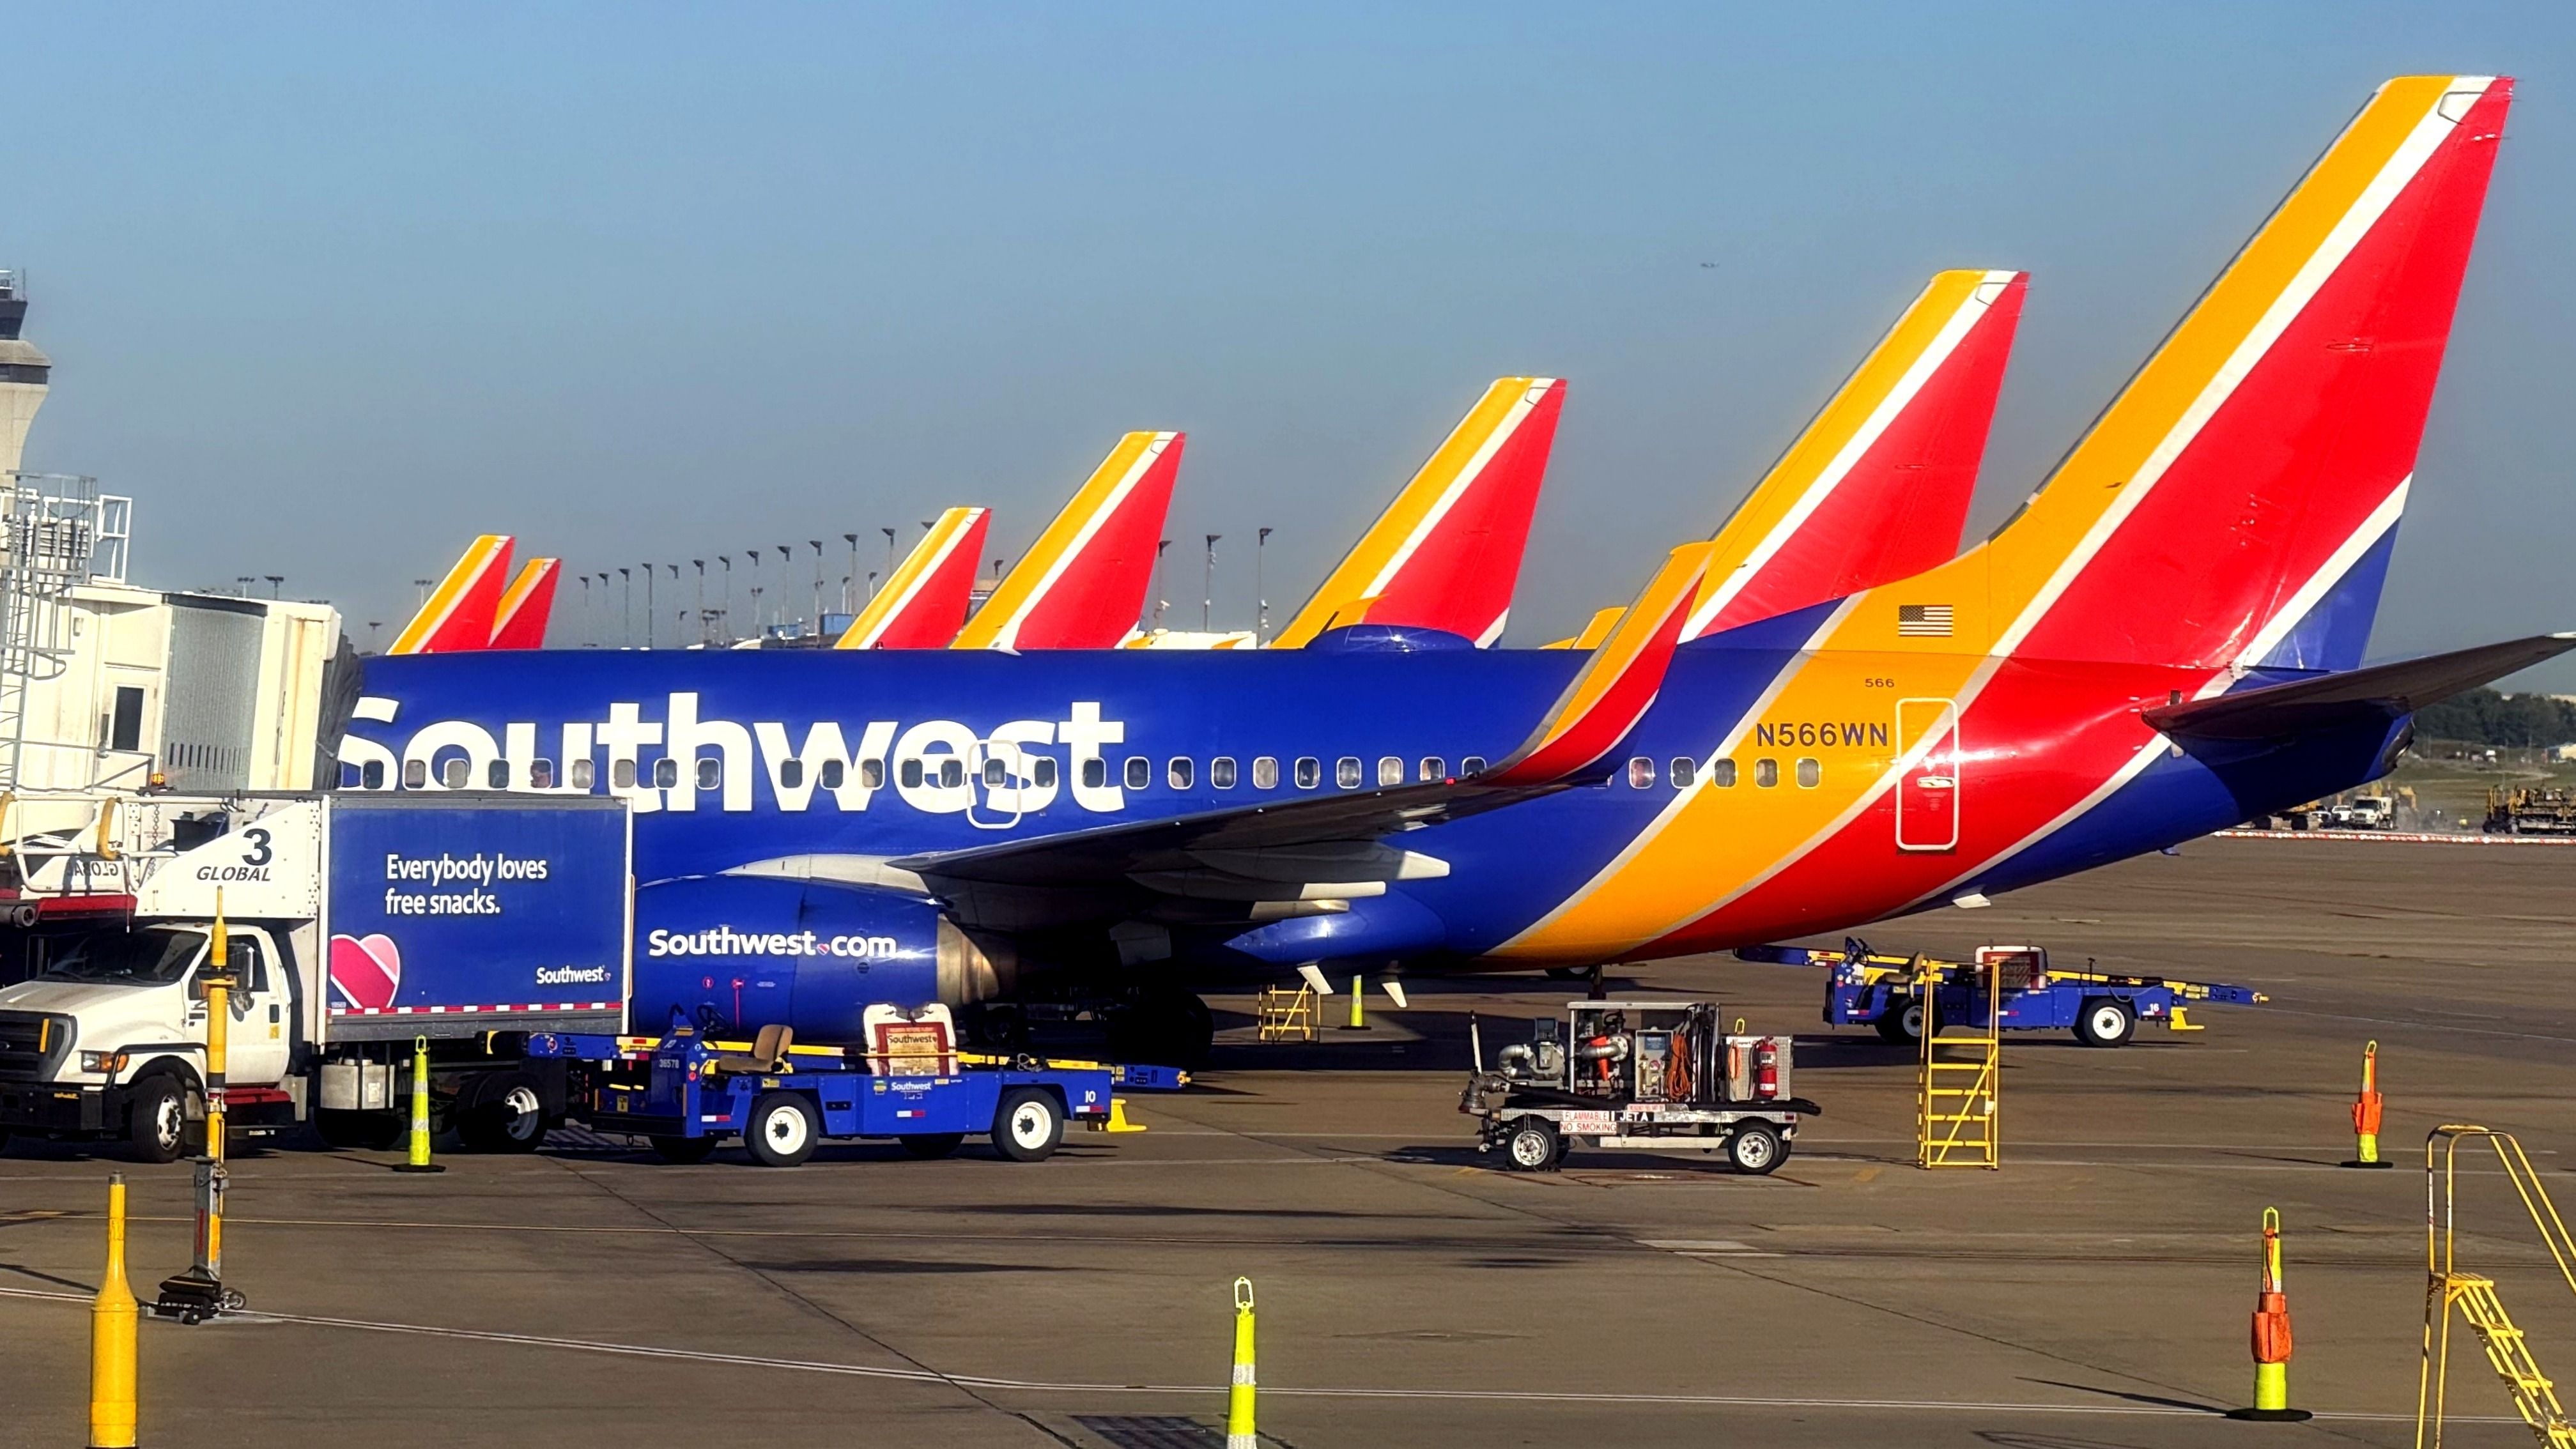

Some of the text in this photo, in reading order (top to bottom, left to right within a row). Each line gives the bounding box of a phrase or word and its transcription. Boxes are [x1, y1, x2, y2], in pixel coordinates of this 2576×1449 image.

[1865, 678, 1895, 688] 566
[1757, 722, 1888, 747] N566WN
[336, 692, 1125, 813] Southwest
[241, 827, 273, 866] 3
[196, 866, 272, 882] GLOBAL
[386, 853, 548, 887] Everybody loves
[385, 887, 501, 915] free snacks.
[536, 965, 605, 985] Southwest
[2149, 1002, 2160, 1013] 16
[887, 1034, 932, 1044] Southwest
[891, 1081, 932, 1091] Southwest
[1084, 1090, 1097, 1103] 10
[1564, 1112, 1608, 1121] FLAMMABLE
[1619, 1112, 1649, 1121] JET A
[1560, 1123, 1617, 1131] NO SMOKING
